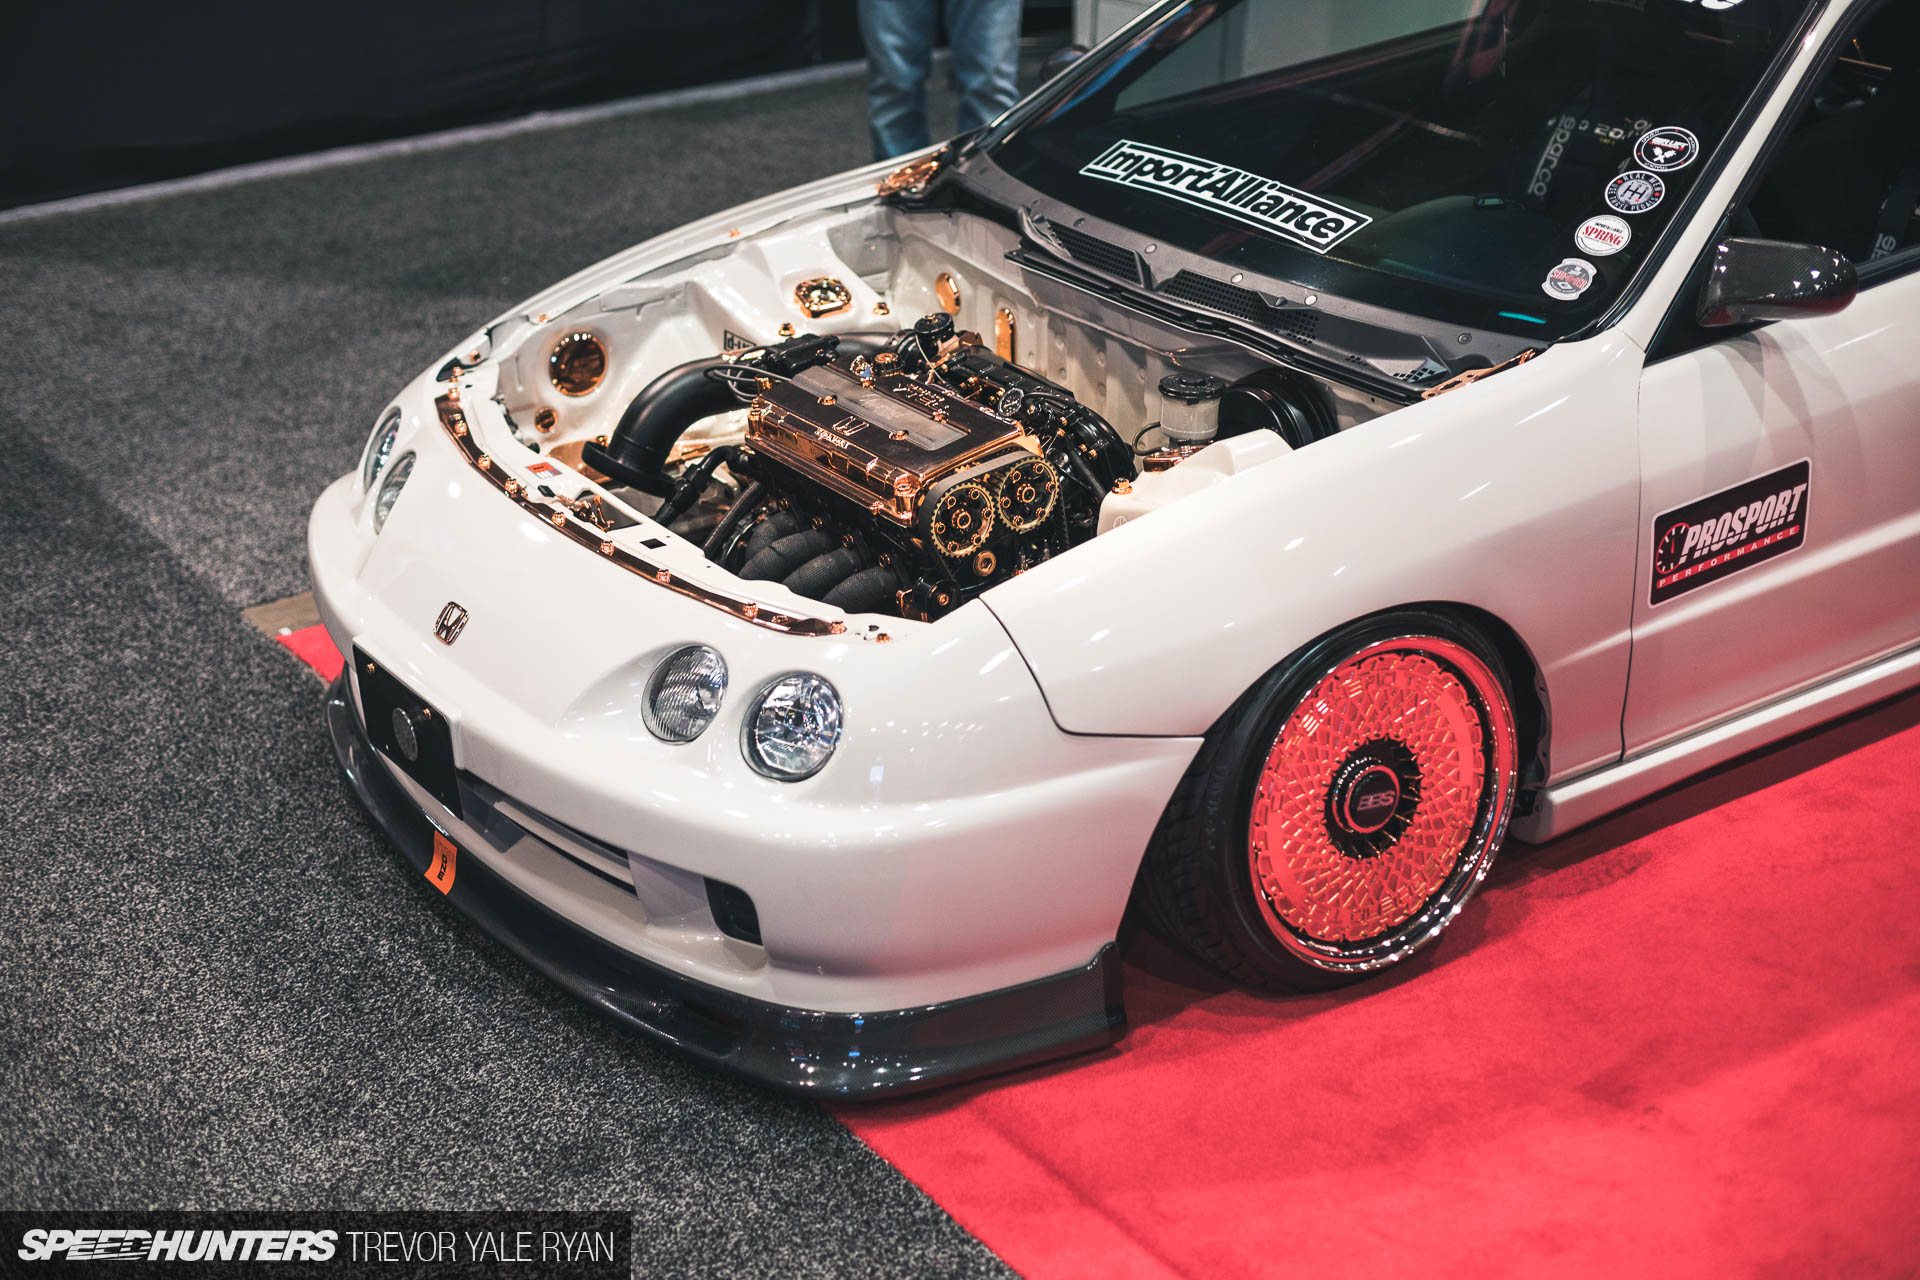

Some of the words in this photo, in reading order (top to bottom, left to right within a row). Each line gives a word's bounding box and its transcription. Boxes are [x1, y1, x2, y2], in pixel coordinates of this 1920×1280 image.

[1622, 173, 1646, 182] REAL
[1101, 144, 1346, 240] ImportAlliance
[1630, 196, 1660, 211] PEDALS
[1582, 225, 1624, 246] SPRING
[1678, 482, 1808, 566] PROSPORT
[1659, 526, 1796, 588] PERFORMANCE
[1357, 789, 1396, 811] BBS
